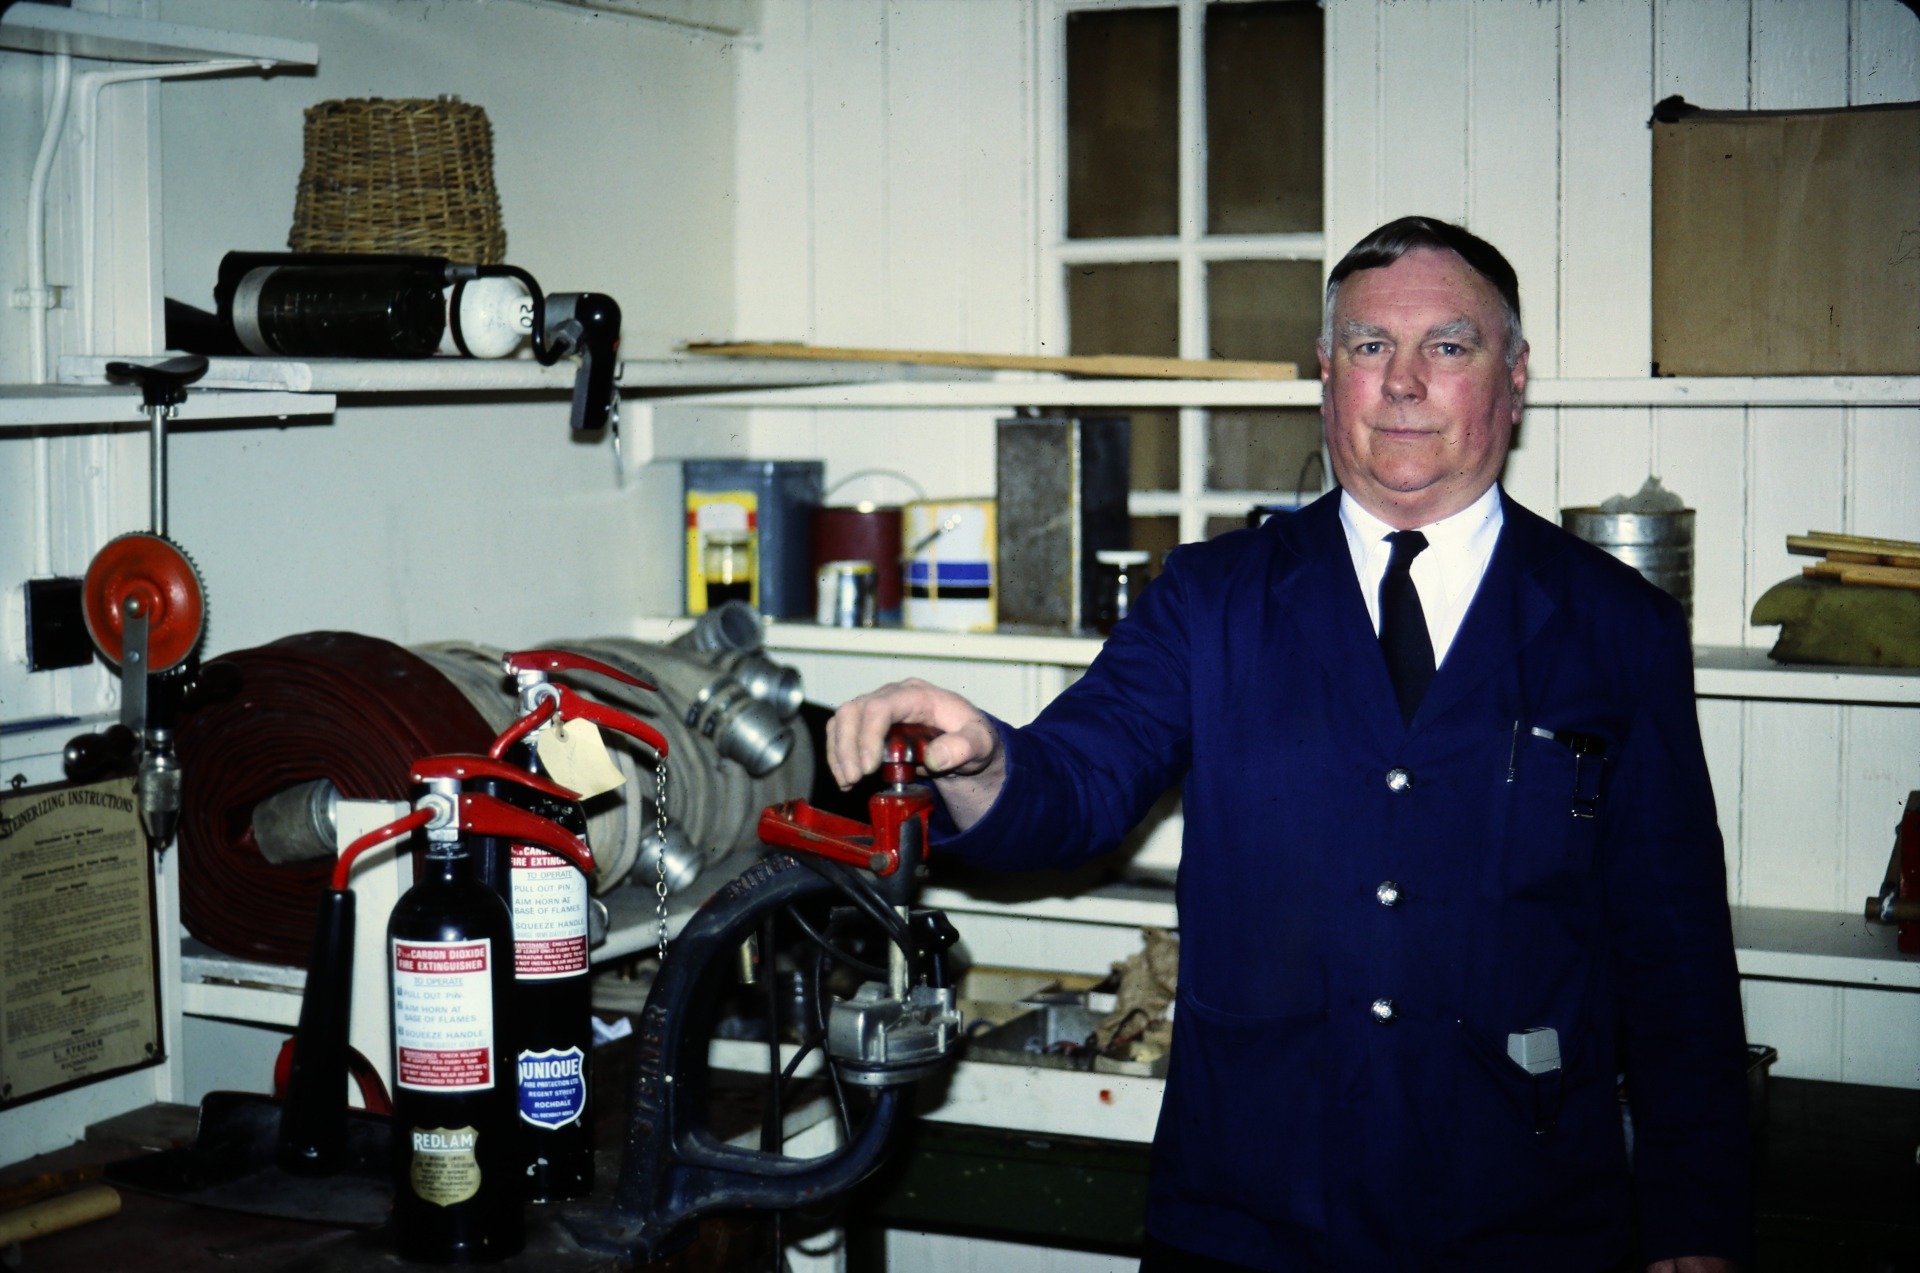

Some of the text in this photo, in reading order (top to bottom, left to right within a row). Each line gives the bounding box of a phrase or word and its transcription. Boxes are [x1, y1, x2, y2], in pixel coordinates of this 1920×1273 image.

[1, 793, 65, 836] STEINERIZING
[68, 790, 134, 813] INSTRUCTIONS
[527, 870, 573, 880] TO OPERATE
[514, 885, 534, 893] PULL
[537, 885, 554, 893] OUT
[515, 898, 532, 906] AIM
[535, 898, 560, 906] HORN
[514, 905, 581, 915] BASE OF FLAMES
[515, 918, 586, 930] SQUEEZE HANDLE
[410, 949, 447, 960] CARBON
[449, 947, 485, 960] DIOXIDE
[399, 959, 483, 971] FIRE EXTINGUISHER
[414, 977, 464, 986] TO OPERATE
[403, 990, 421, 999] PULL
[423, 991, 441, 1000] OUT
[404, 1004, 419, 1012] AIM
[422, 1005, 448, 1014] HORN
[451, 1005, 461, 1013] AT
[404, 1014, 477, 1024] BASE OF FLAMES
[405, 1028, 441, 1039] SQUEEZE
[446, 1028, 483, 1039] HANDLE
[66, 1038, 103, 1055] STEINER
[522, 1058, 579, 1080] UNIQUE
[536, 1079, 570, 1088] PROTECTION
[528, 1088, 576, 1098] REGENT STREET
[534, 1099, 572, 1108] ROCHDALE
[413, 1132, 474, 1152] REDLAM
